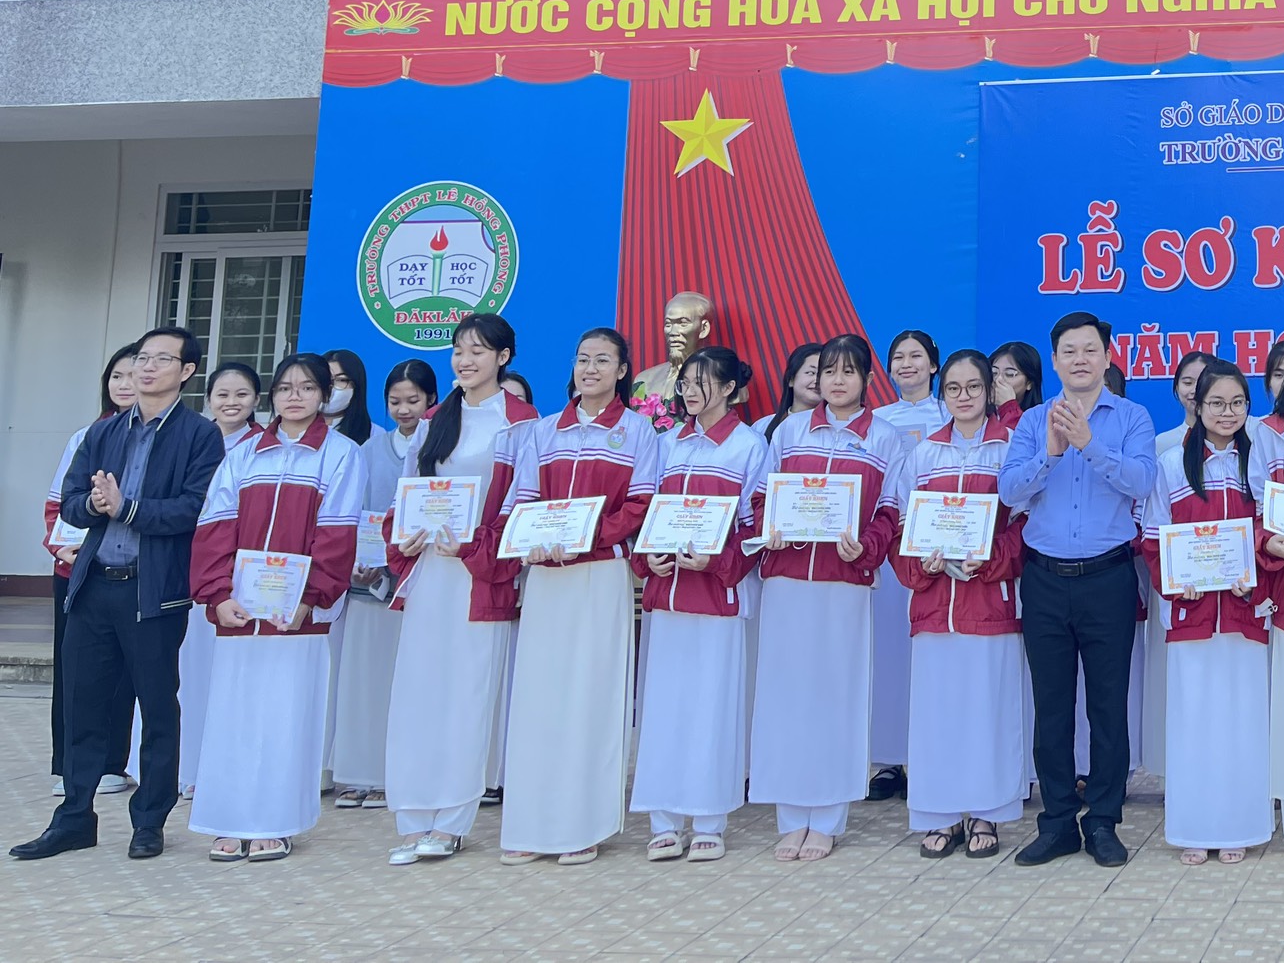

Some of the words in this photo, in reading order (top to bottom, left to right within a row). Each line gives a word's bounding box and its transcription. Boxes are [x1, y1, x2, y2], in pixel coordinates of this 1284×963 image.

[1160, 101, 1194, 128] SỞ
[1198, 99, 1262, 126] GIÁO
[1160, 133, 1284, 164] TRƯỜNG
[364, 225, 390, 297] TRƯỜNG
[388, 192, 431, 222] THPT
[436, 187, 458, 202] LÊ
[461, 193, 502, 230] HỒNG
[492, 233, 511, 294] PHONG
[1038, 199, 1126, 294] LỄ
[1142, 215, 1238, 292] SƠ
[399, 262, 429, 272] DẠY
[450, 262, 477, 272] HỌC
[398, 273, 426, 286] TỐT
[449, 273, 475, 285] TỐT
[414, 328, 453, 341] 1991
